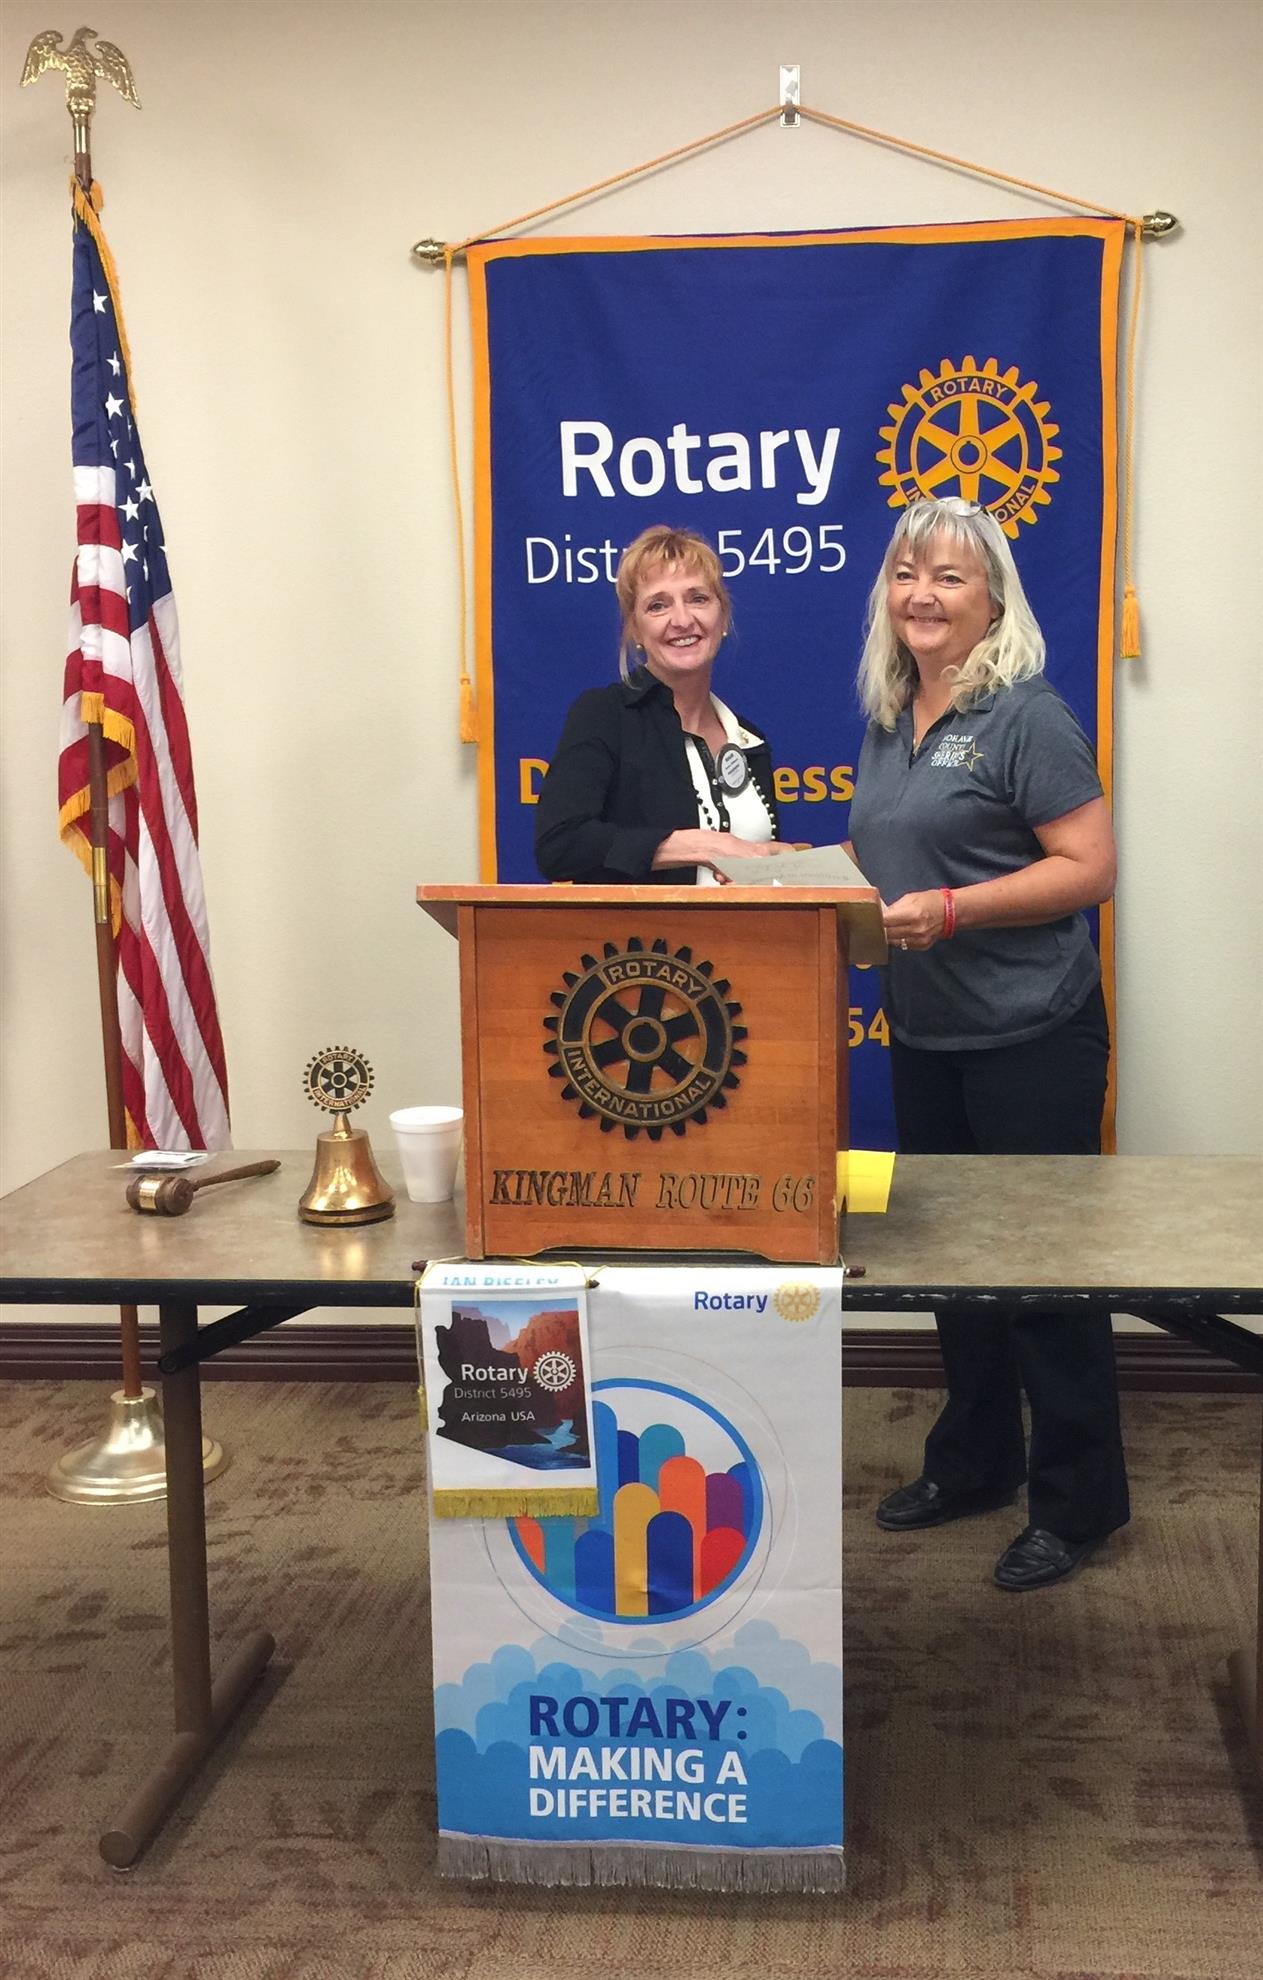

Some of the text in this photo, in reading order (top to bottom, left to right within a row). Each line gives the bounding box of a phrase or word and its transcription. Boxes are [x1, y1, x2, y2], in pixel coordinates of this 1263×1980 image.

[930, 378, 1008, 402] ROTARY
[559, 420, 841, 506] Rotary
[525, 524, 847, 584] Dist 5495
[608, 960, 705, 995] ROTARY
[567, 1050, 712, 1119] INTERNATIONAL
[489, 1169, 816, 1213] KINGMAN ROUTE 66
[694, 1291, 768, 1313] Rotary
[461, 1363, 529, 1384] Rotary
[454, 1387, 532, 1400] District 5495
[461, 1410, 536, 1422] Arizona USA
[529, 1695, 748, 1741] ROTARY:
[529, 1745, 748, 1785] MAKING A
[529, 1787, 748, 1824] DIFFERENCE
